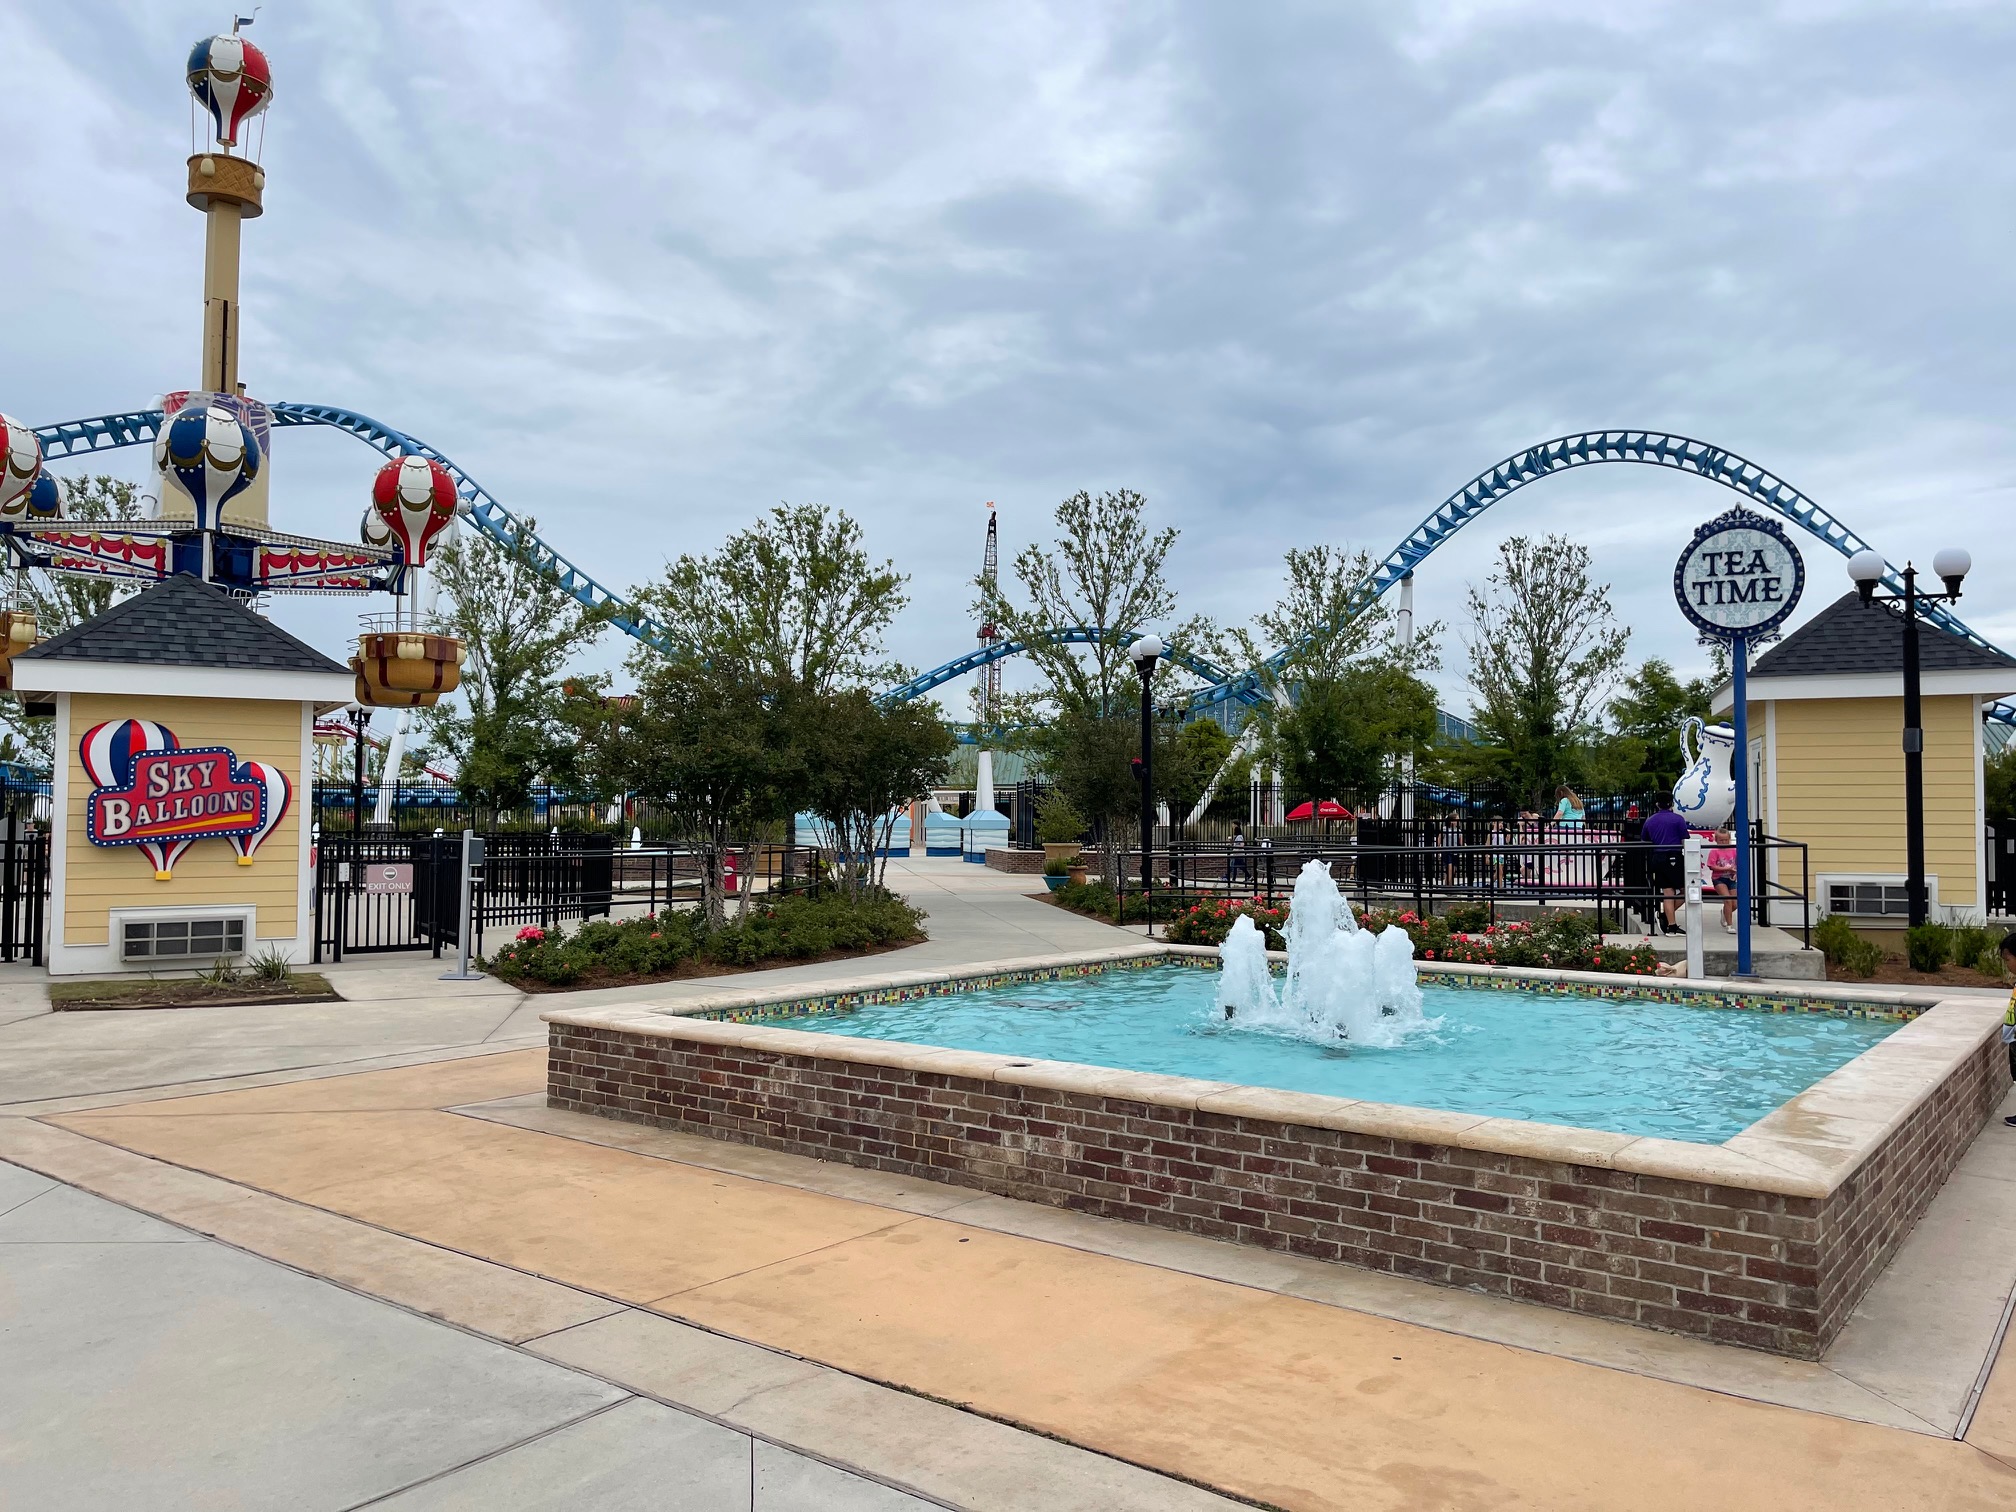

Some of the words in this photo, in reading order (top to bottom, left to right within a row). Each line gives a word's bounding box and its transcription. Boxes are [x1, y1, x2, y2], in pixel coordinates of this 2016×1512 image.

[1702, 549, 1771, 577] TEA
[1692, 577, 1783, 605] TIME
[147, 760, 217, 798] SKY
[101, 790, 256, 837] BALLOONS
[368, 882, 386, 891] EXIT
[388, 882, 411, 890] ONLY
